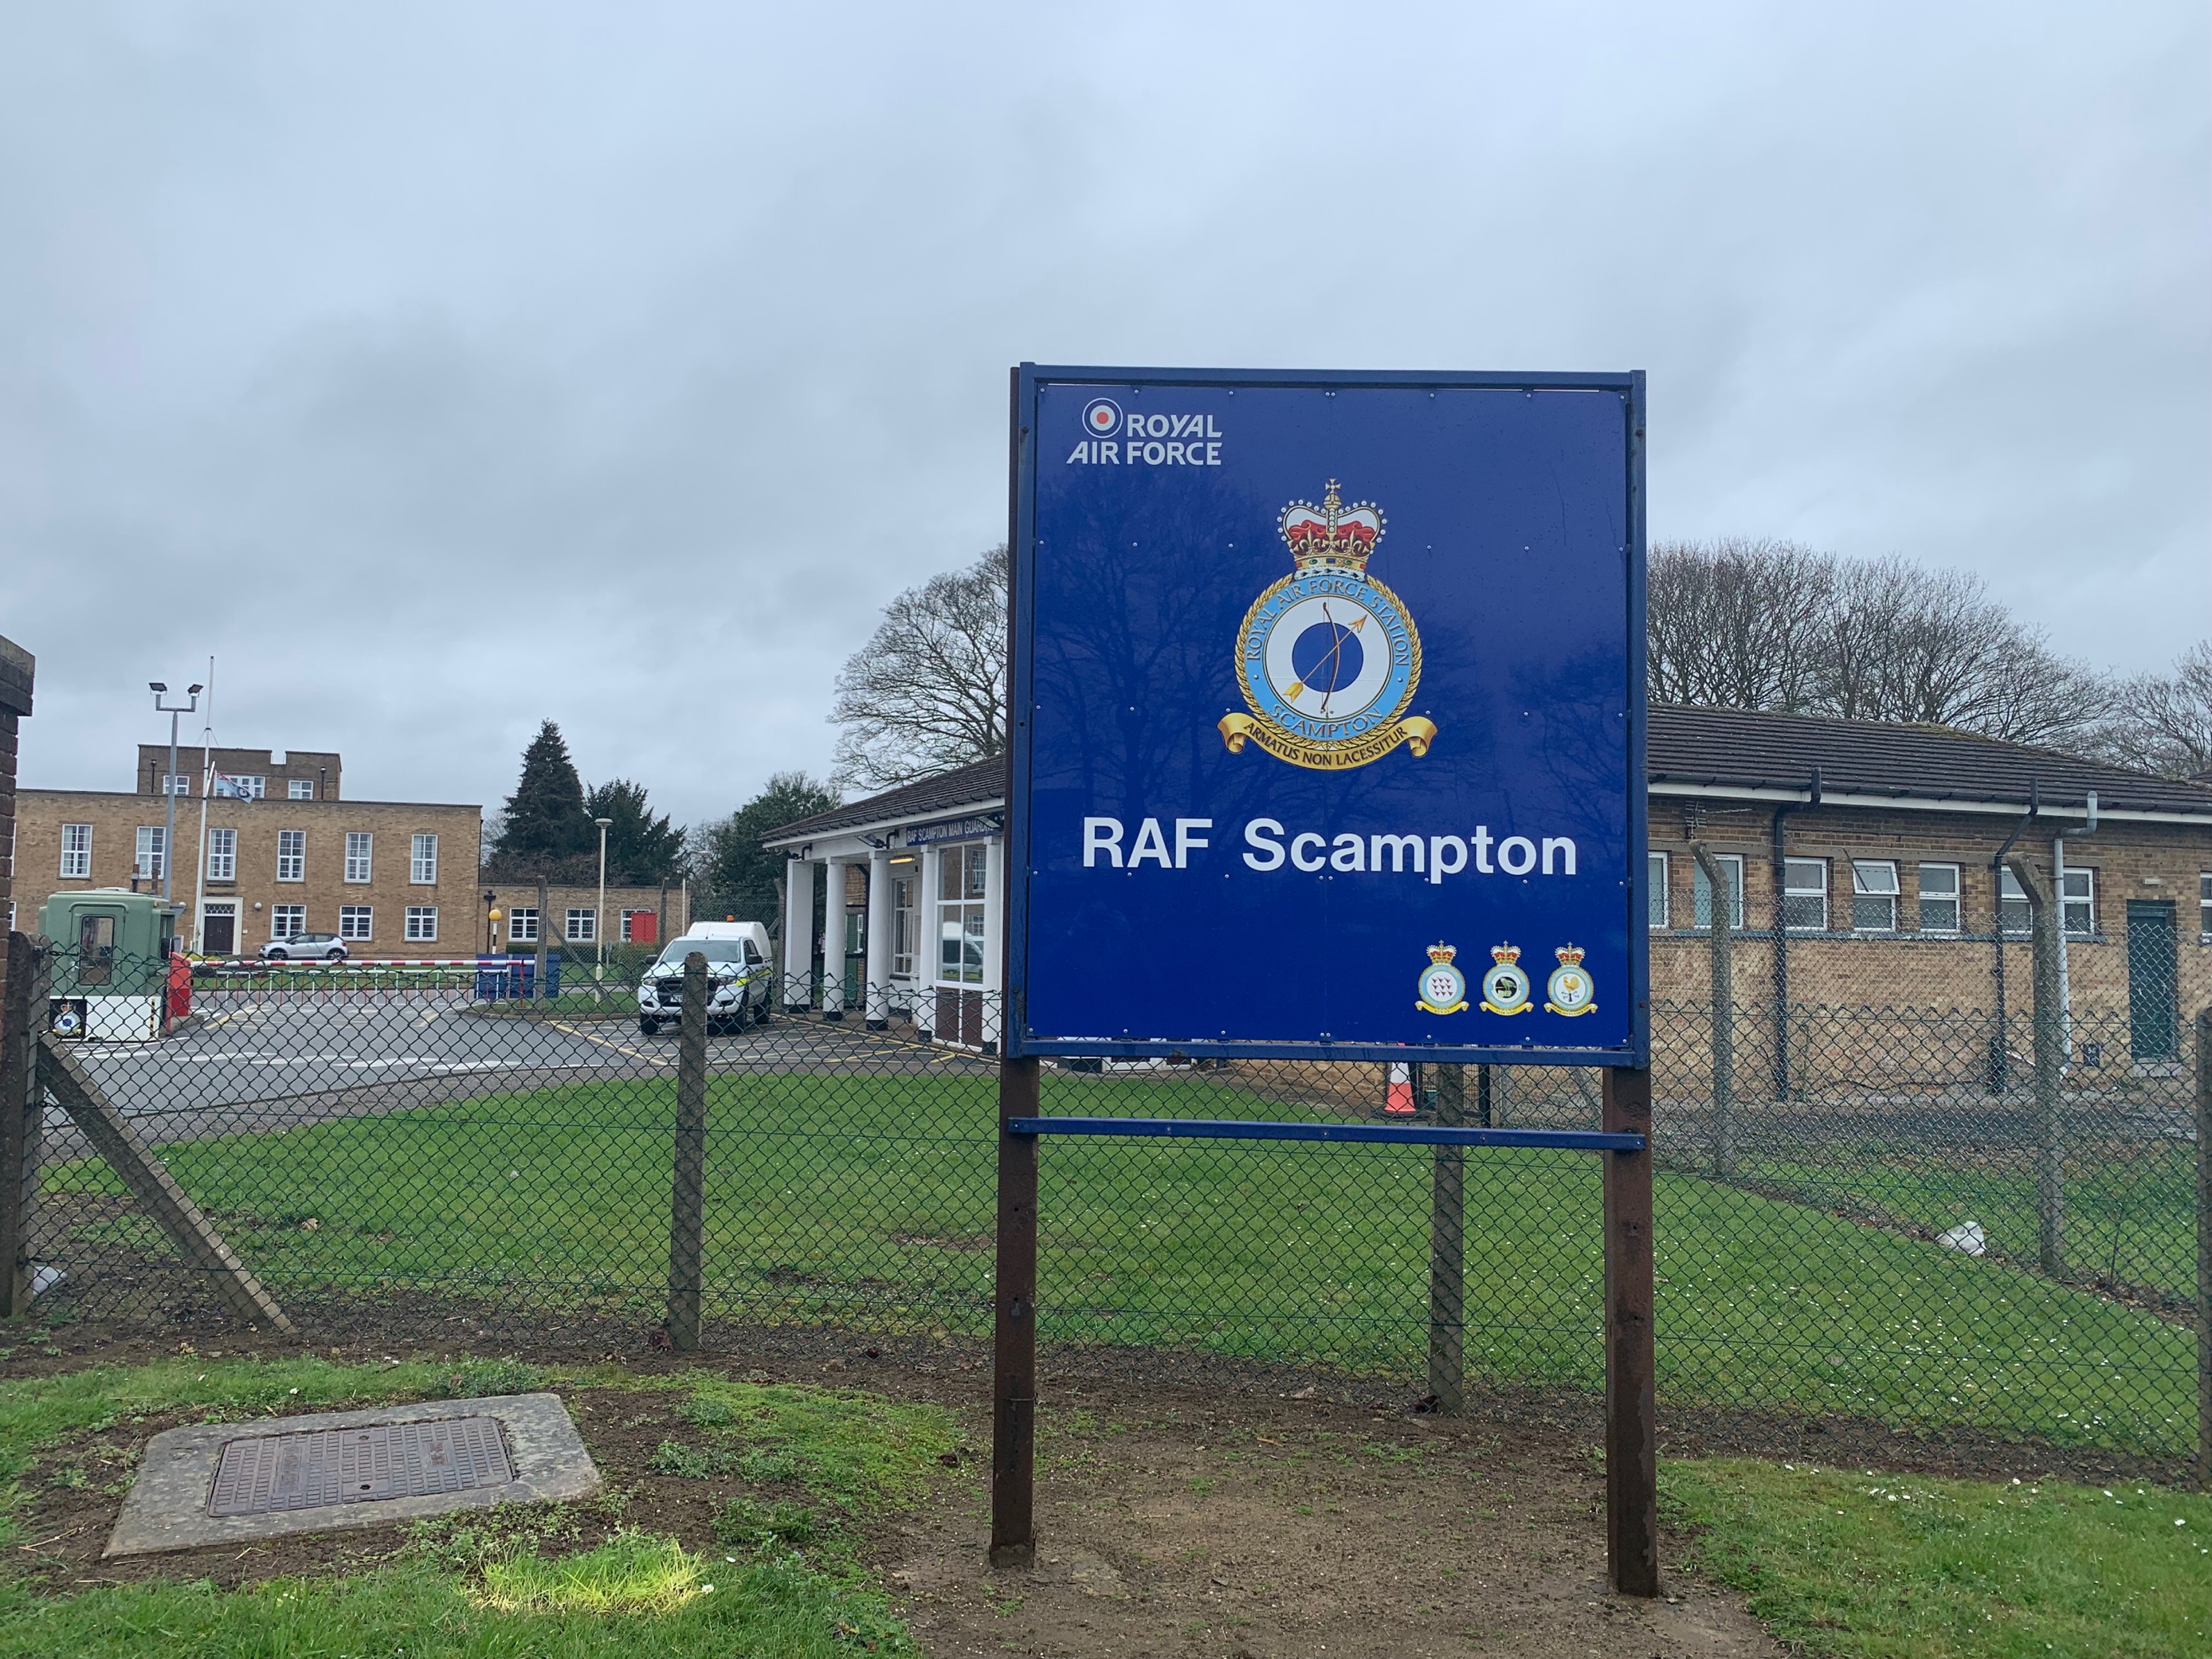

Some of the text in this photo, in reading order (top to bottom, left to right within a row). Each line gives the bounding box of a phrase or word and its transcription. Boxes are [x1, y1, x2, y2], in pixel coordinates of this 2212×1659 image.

[1127, 414, 1222, 437] ROYAL
[1066, 441, 1222, 465] AIR FORCE
[1246, 578, 1410, 666] ROYAL AIR FORCE STATION
[1268, 704, 1384, 738] SCAMPTON
[1244, 721, 1408, 767] ARMATUS NON LACESSITUR
[907, 830, 917, 843] RAF
[918, 825, 947, 841] SCAMPTON
[948, 822, 963, 837] MAIN
[1083, 817, 1577, 884] RAF Scampton
